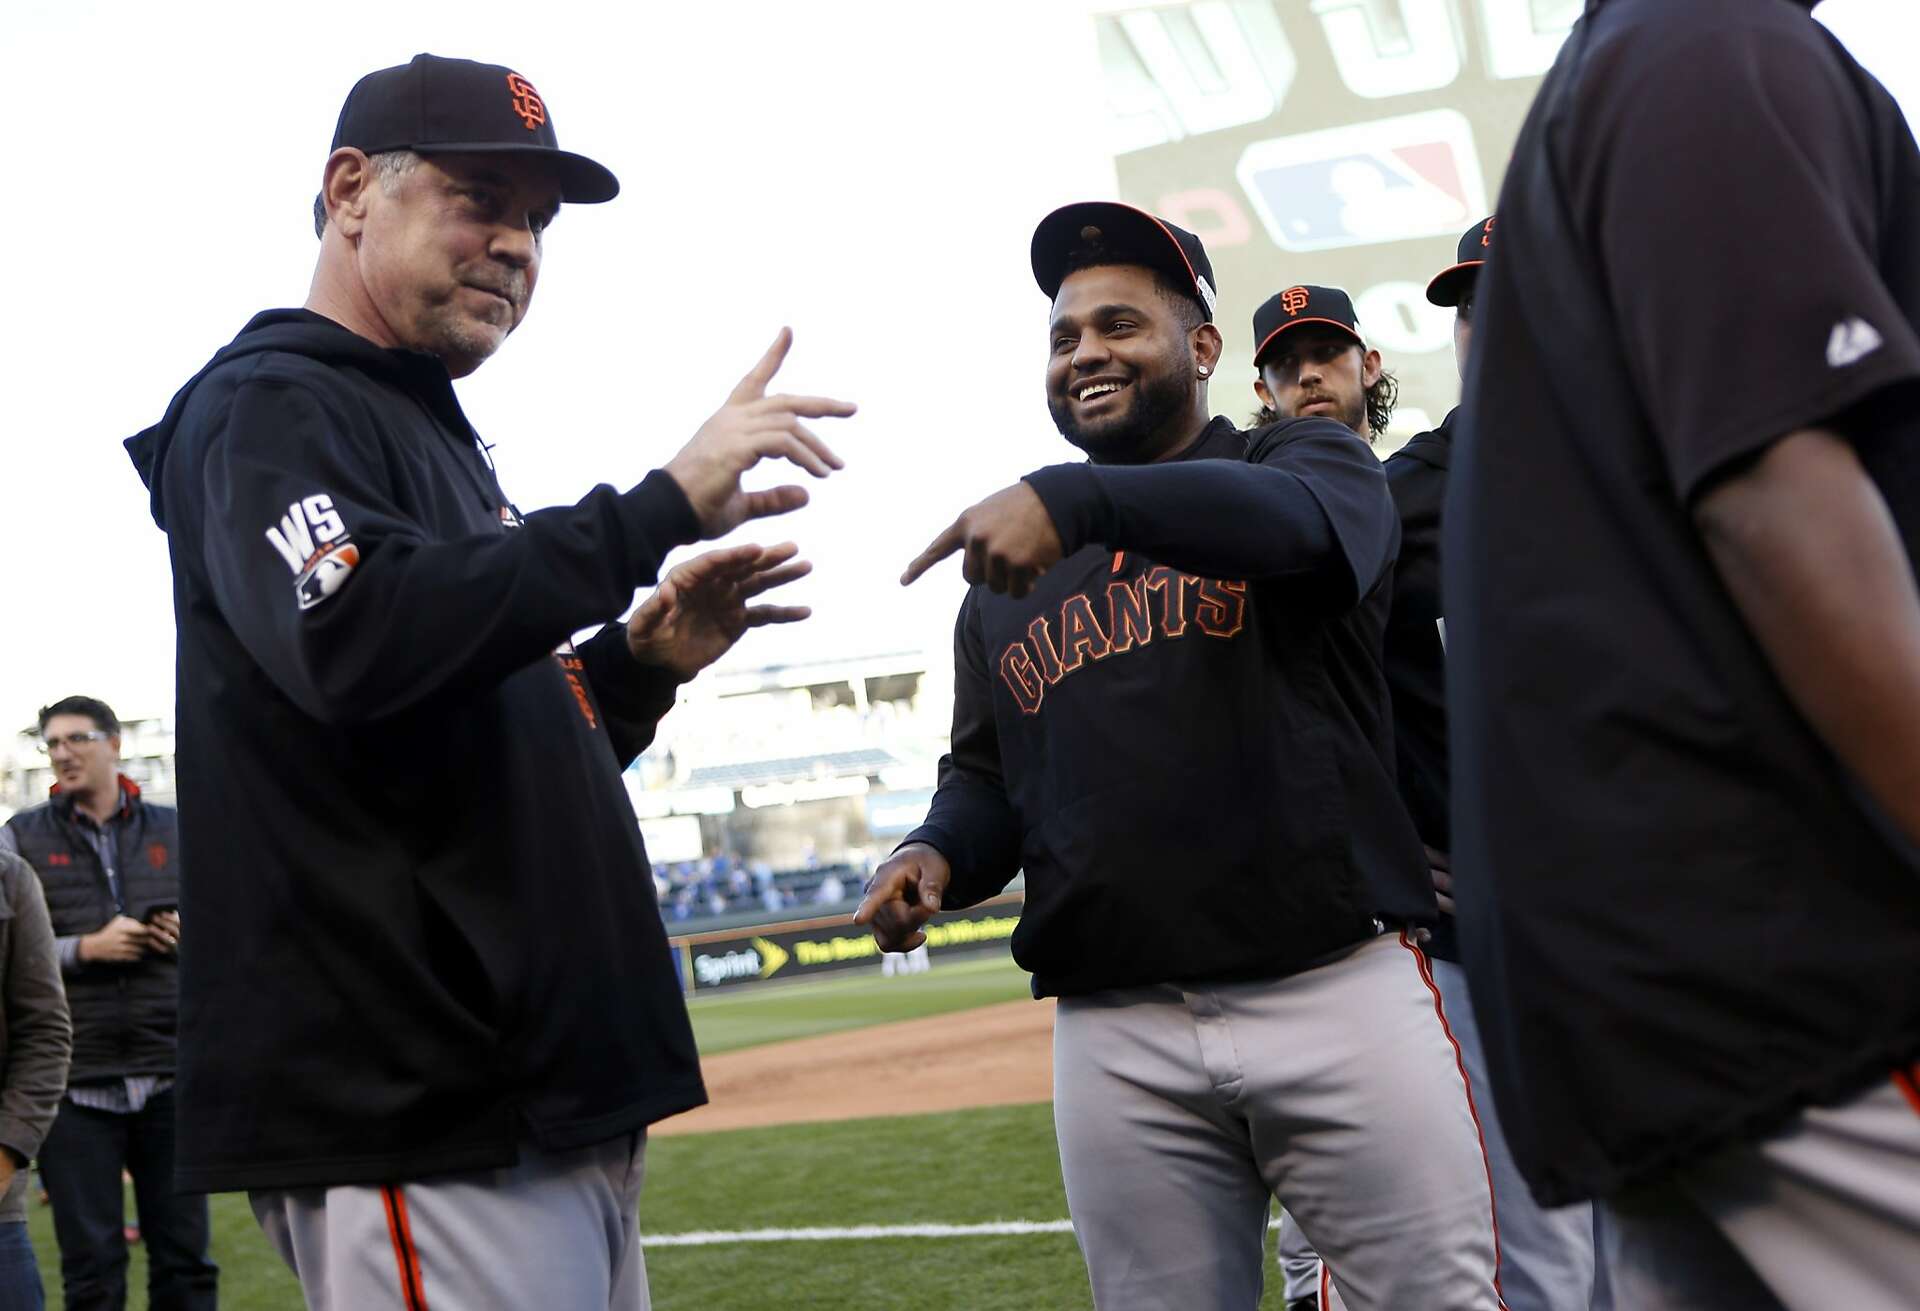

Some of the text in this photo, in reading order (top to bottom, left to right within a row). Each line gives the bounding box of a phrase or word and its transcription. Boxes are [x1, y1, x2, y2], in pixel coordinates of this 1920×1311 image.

[265, 493, 346, 576] WS
[1000, 565, 1248, 714] GIANTS
[694, 948, 763, 986] Sprint
